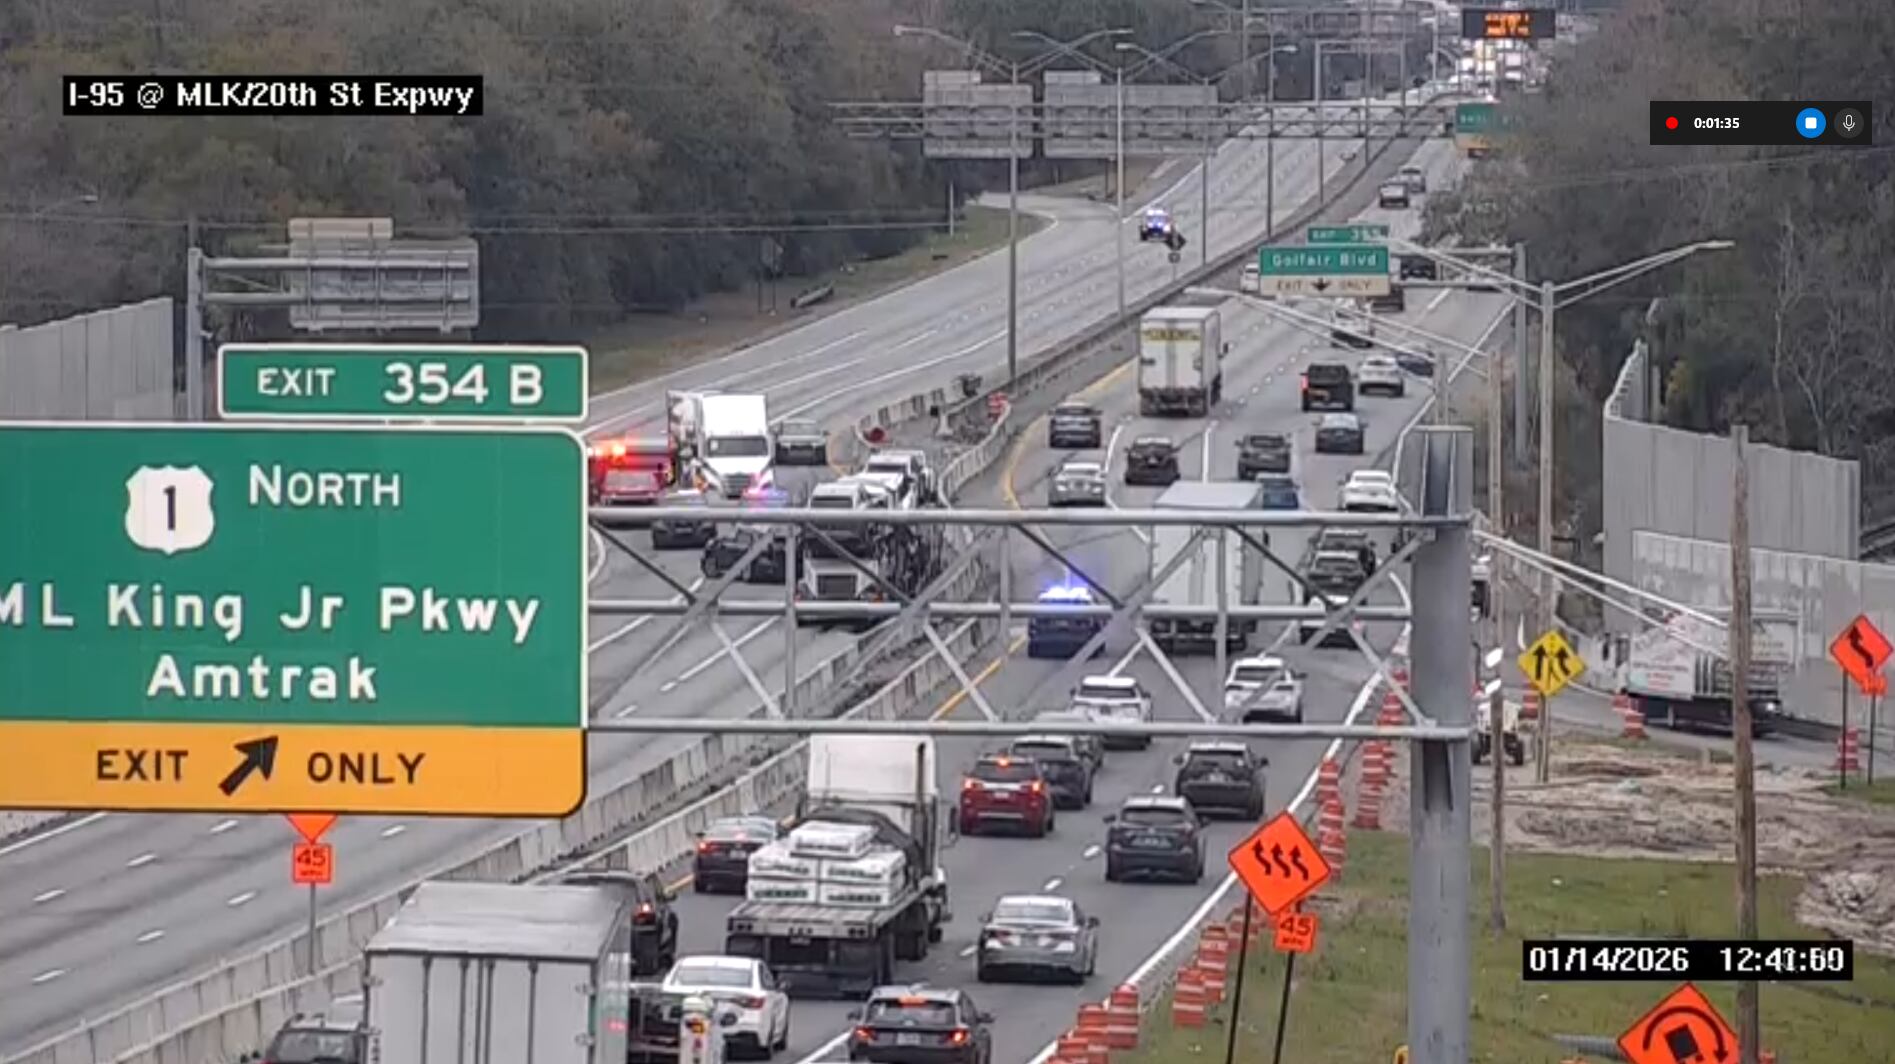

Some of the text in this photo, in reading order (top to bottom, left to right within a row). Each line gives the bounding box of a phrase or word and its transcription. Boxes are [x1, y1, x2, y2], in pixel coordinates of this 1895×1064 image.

[1340, 252, 1376, 267] Blvd
[257, 363, 543, 404] EXIT 354 B
[249, 465, 400, 506] NORTH
[163, 485, 176, 531] 1
[108, 585, 243, 641] King
[280, 587, 343, 629] Jr
[380, 588, 539, 643] Pkwy
[147, 655, 377, 699] Amtrak
[96, 749, 426, 785] EXIT ONLY
[297, 848, 326, 866] 45
[1280, 916, 1311, 936] 45
